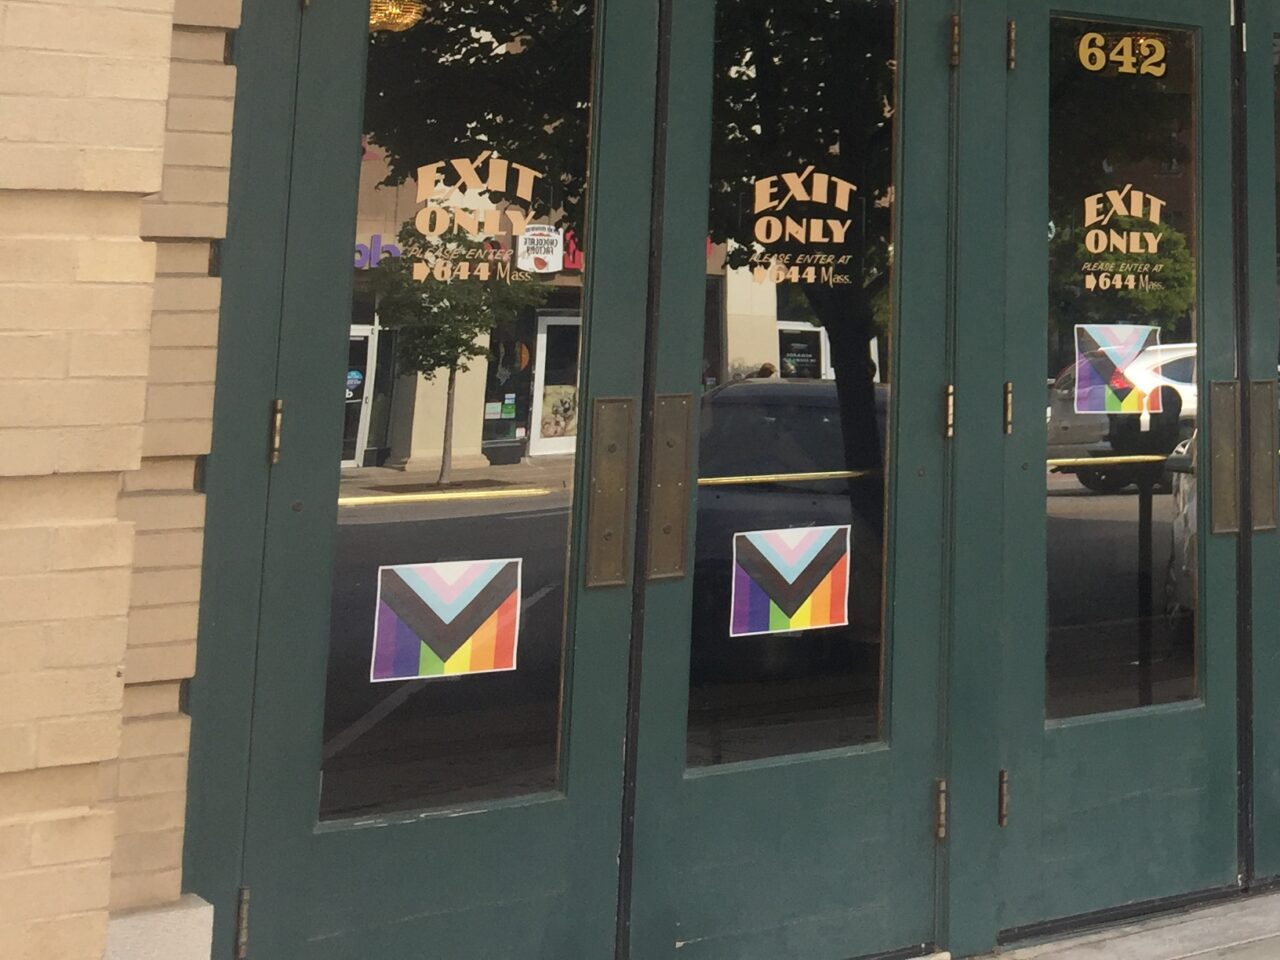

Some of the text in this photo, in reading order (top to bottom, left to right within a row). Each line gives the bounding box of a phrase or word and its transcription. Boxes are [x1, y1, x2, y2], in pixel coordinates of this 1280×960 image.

[1078, 31, 1168, 77] 642
[415, 149, 544, 204] EXIT
[754, 165, 858, 215] EXIT
[1084, 183, 1167, 228] EXIT
[414, 207, 537, 237] ONLY
[754, 215, 853, 245] ONLY
[465, 247, 514, 261] ENTER
[1084, 229, 1164, 255] ONLY
[433, 260, 492, 282] 644
[796, 253, 836, 265] ENTER
[837, 254, 853, 265] AT
[1081, 262, 1165, 273] PLEASE ENTER AT
[769, 263, 817, 284] 644
[1098, 272, 1137, 291] 644
